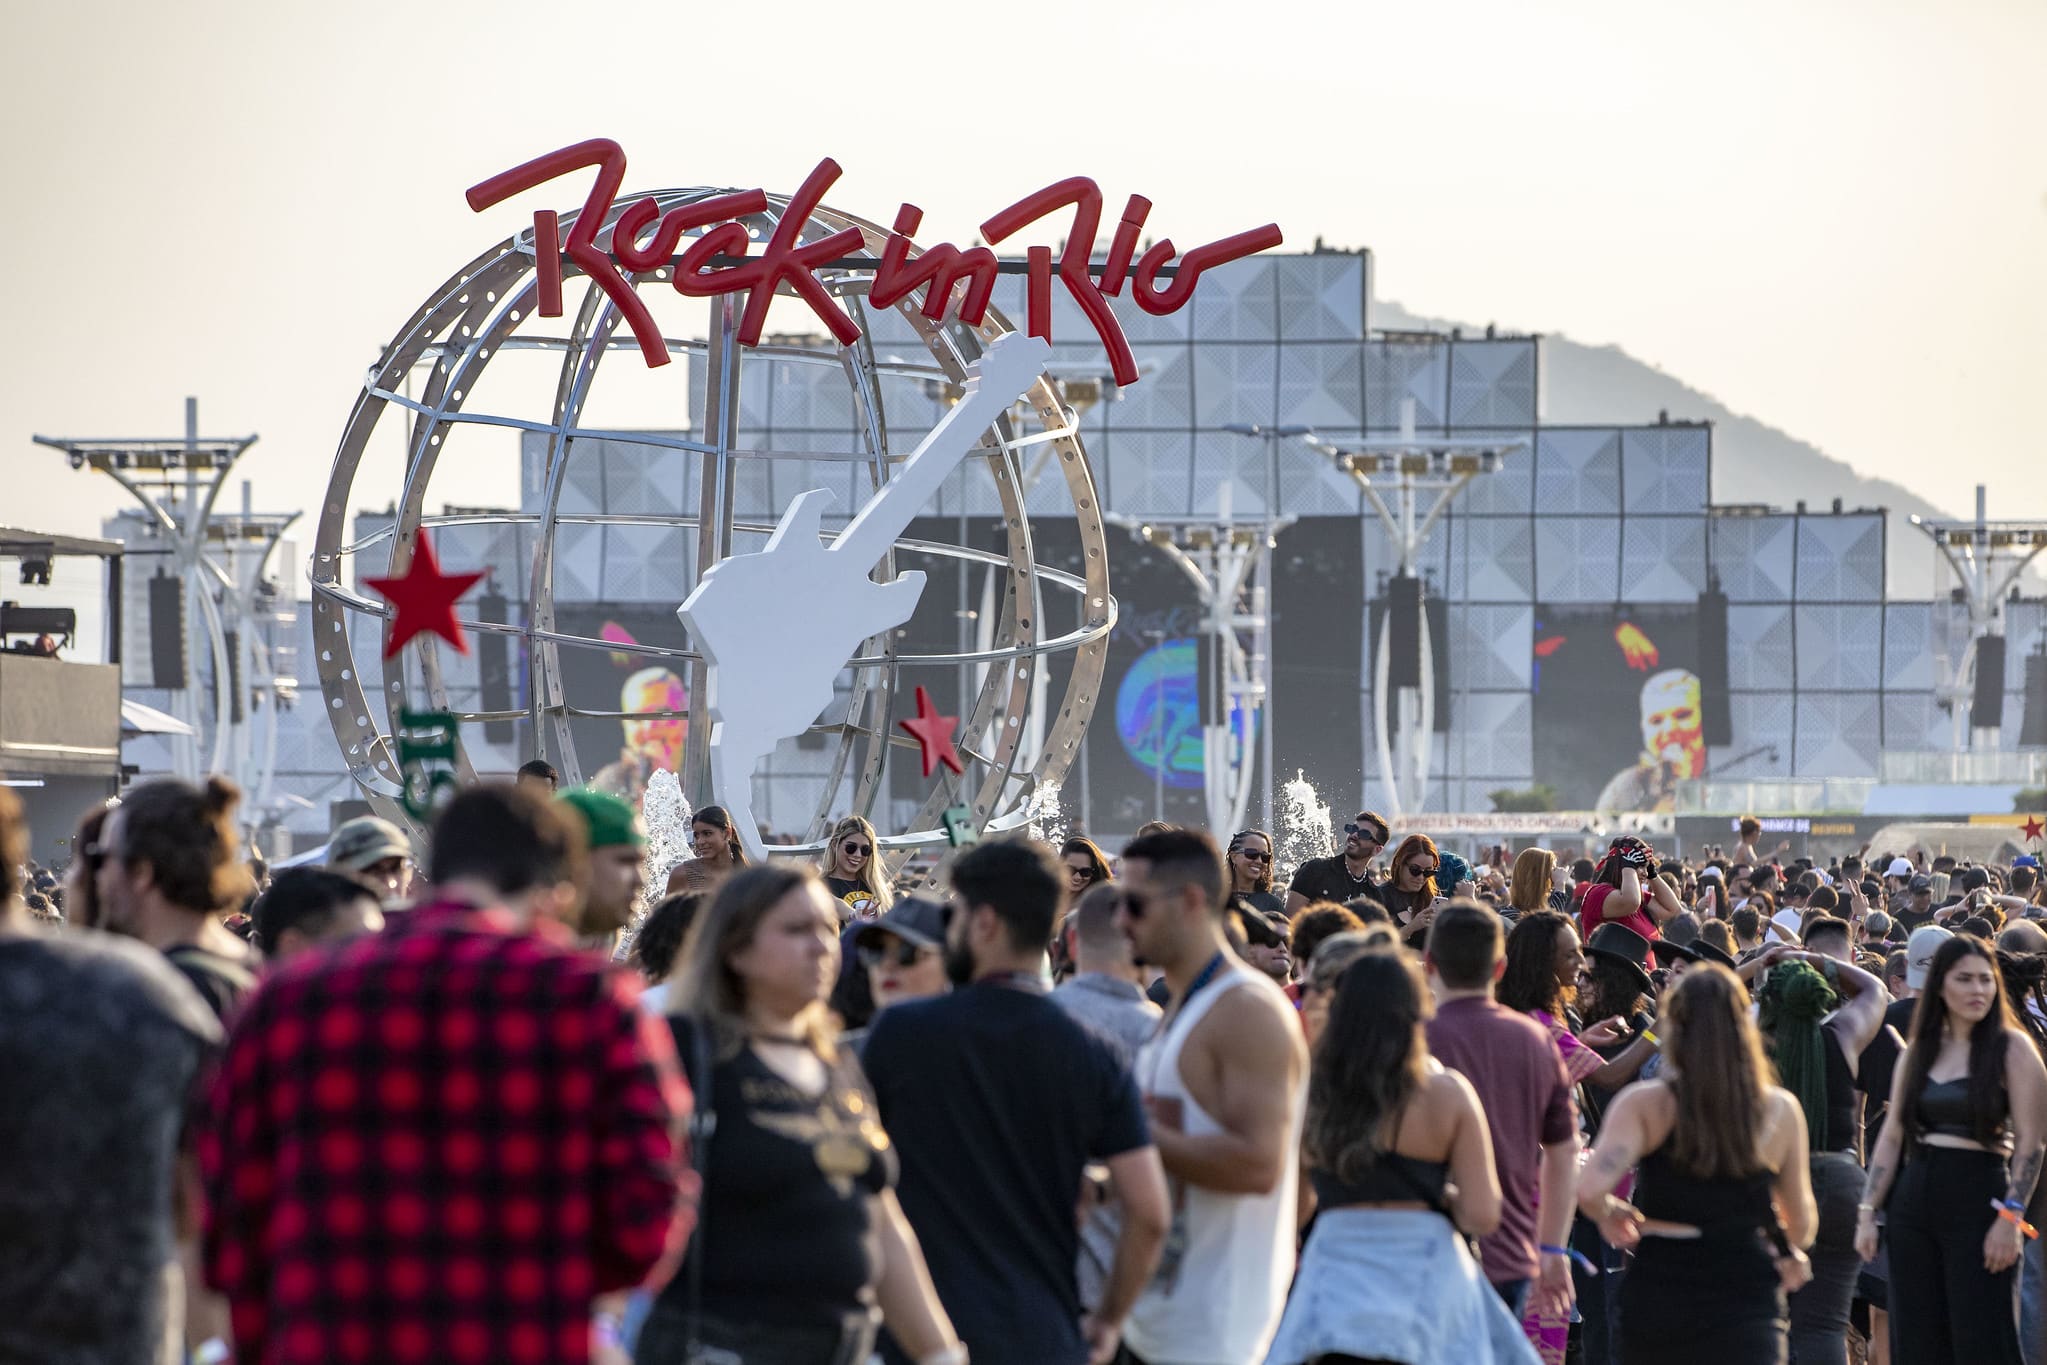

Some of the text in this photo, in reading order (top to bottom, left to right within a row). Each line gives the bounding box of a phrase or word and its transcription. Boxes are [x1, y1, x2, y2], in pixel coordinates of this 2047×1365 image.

[466, 138, 1283, 386] Rock in Rio
